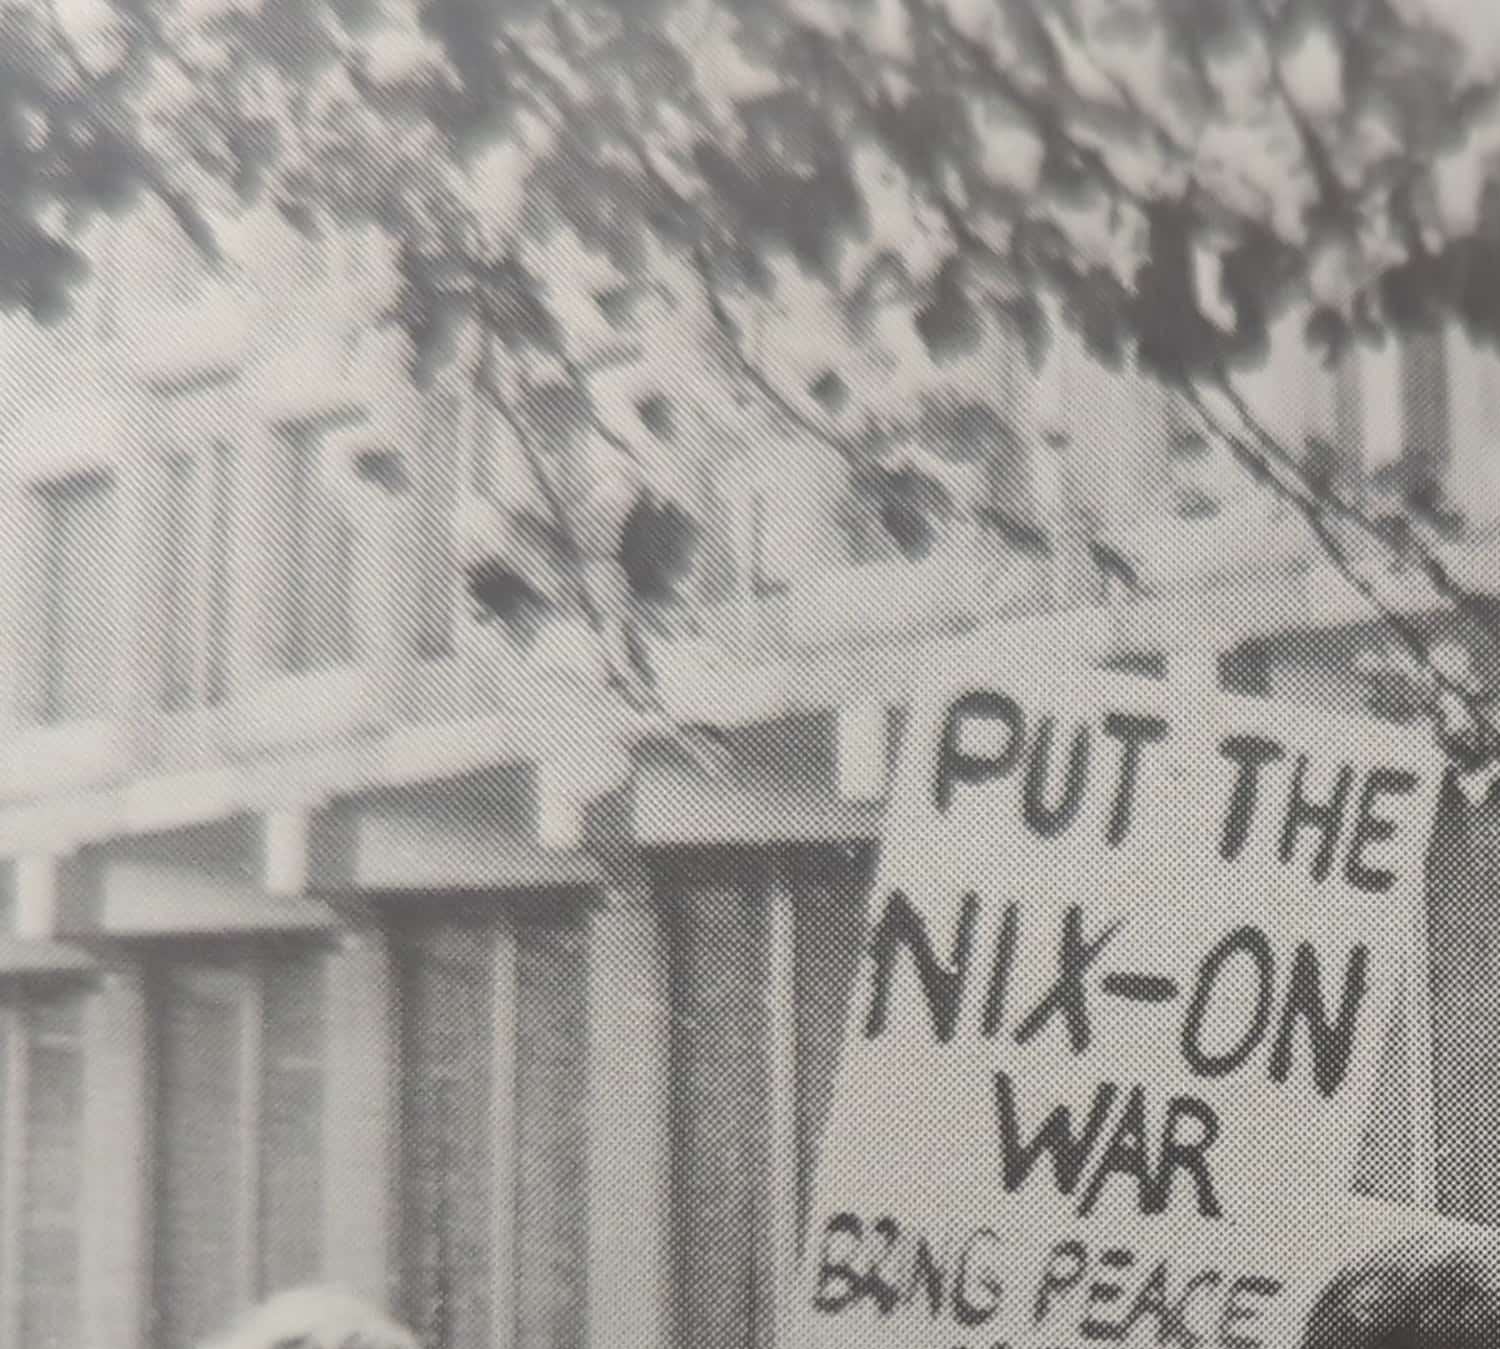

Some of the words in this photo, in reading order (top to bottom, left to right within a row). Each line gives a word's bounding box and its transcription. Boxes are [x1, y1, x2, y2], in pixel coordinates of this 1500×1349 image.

[935, 690, 1170, 848] PUT
[1217, 735, 1419, 892] THE
[864, 888, 1368, 1098] NIX-ON
[995, 1072, 1223, 1218] WAR
